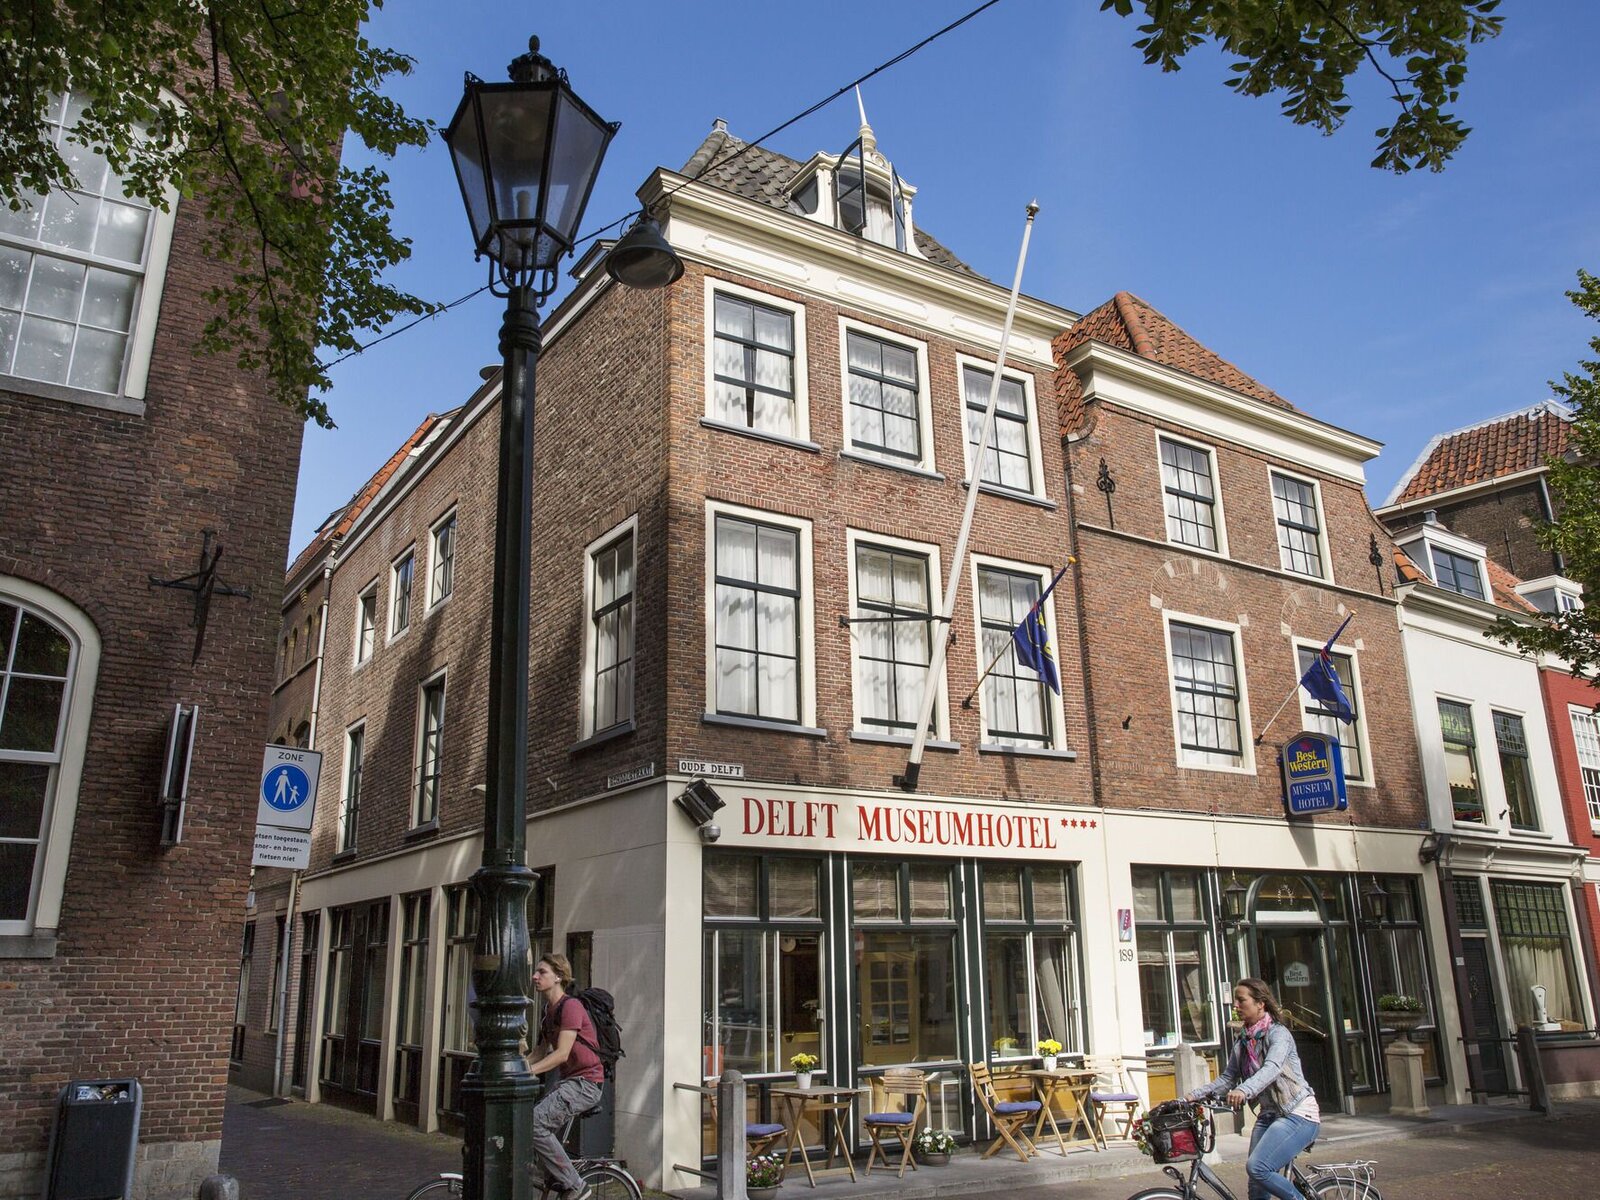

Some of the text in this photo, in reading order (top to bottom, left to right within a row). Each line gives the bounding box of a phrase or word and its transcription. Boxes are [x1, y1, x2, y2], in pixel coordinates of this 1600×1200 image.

[278, 751, 305, 763] ZONE
[1295, 748, 1318, 763] Best
[681, 761, 742, 776] OUDE DELFT
[1289, 758, 1329, 772] Western
[1292, 781, 1331, 796] MUSEUM
[1298, 796, 1329, 809] HOTEL
[741, 797, 1057, 849] DELFT MUSEUMHOTEL
[254, 832, 273, 840] etsen
[259, 852, 282, 861] fietsen
[1119, 948, 1134, 962] 189
